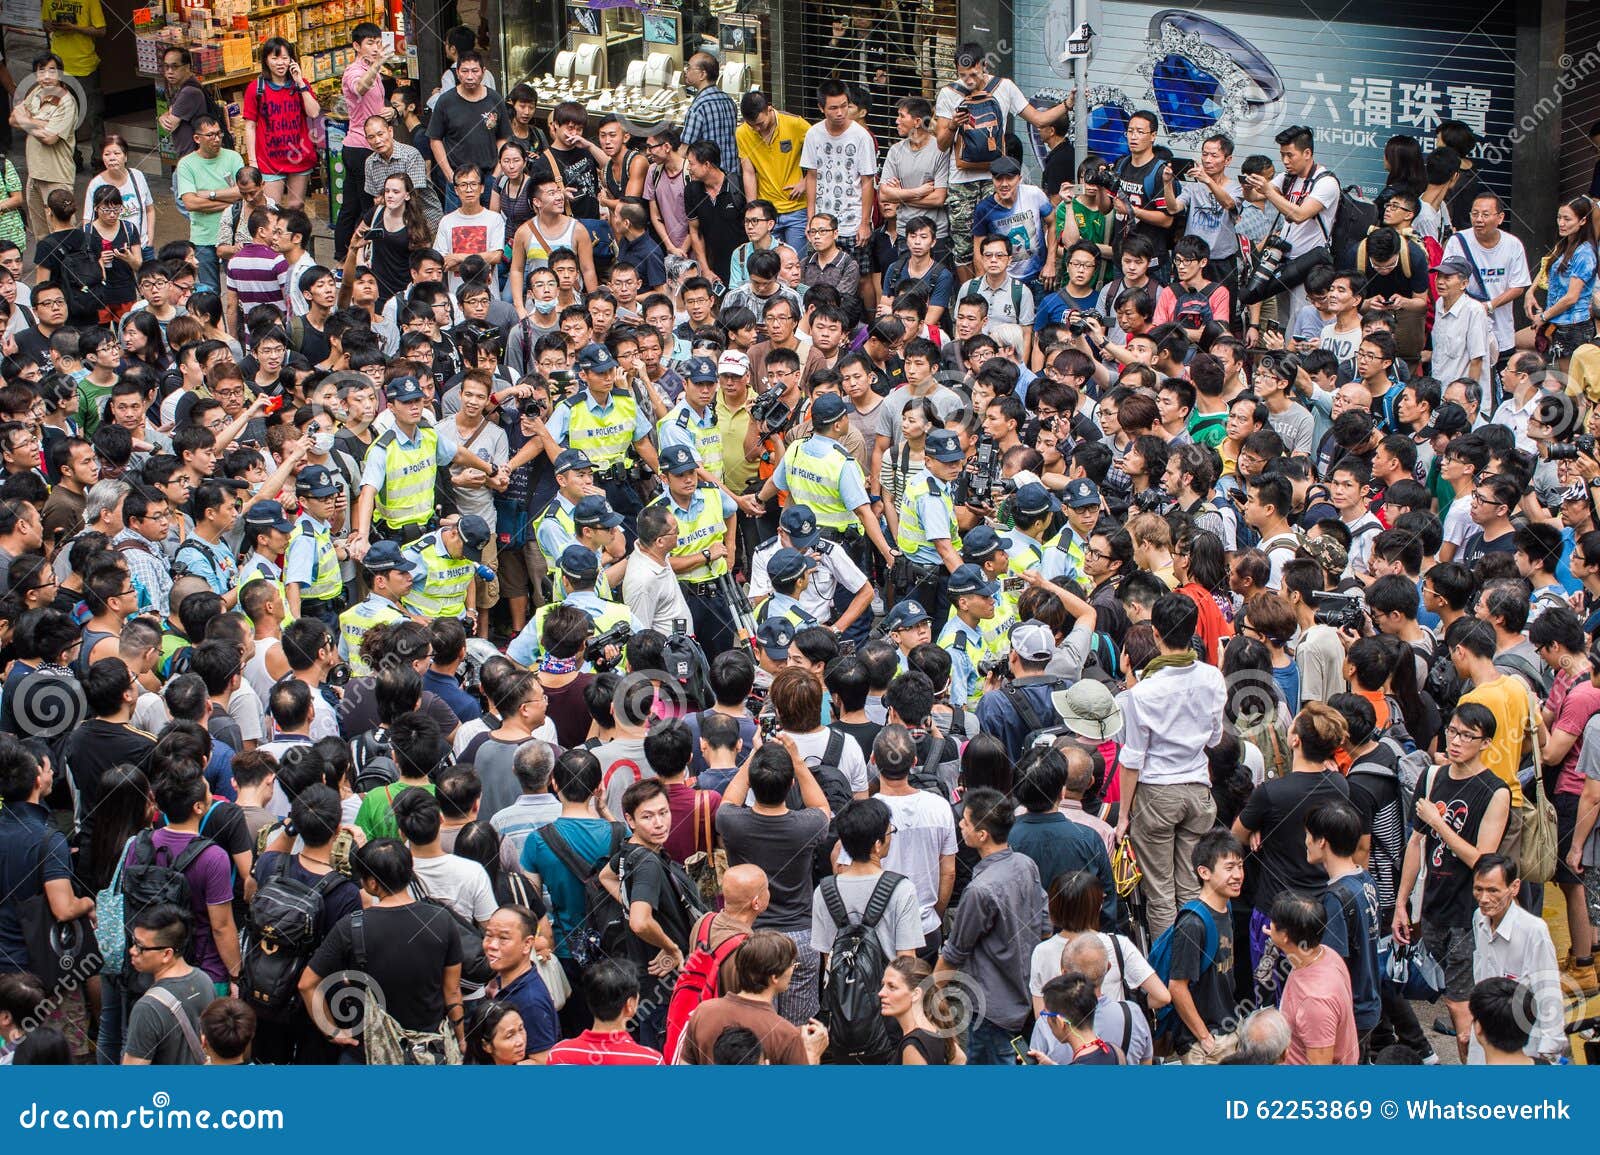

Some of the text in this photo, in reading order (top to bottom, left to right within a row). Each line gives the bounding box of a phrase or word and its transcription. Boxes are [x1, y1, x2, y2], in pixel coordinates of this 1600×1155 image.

[1300, 73, 1491, 137] 六福珠寶
[1321, 337, 1352, 358] FIND
